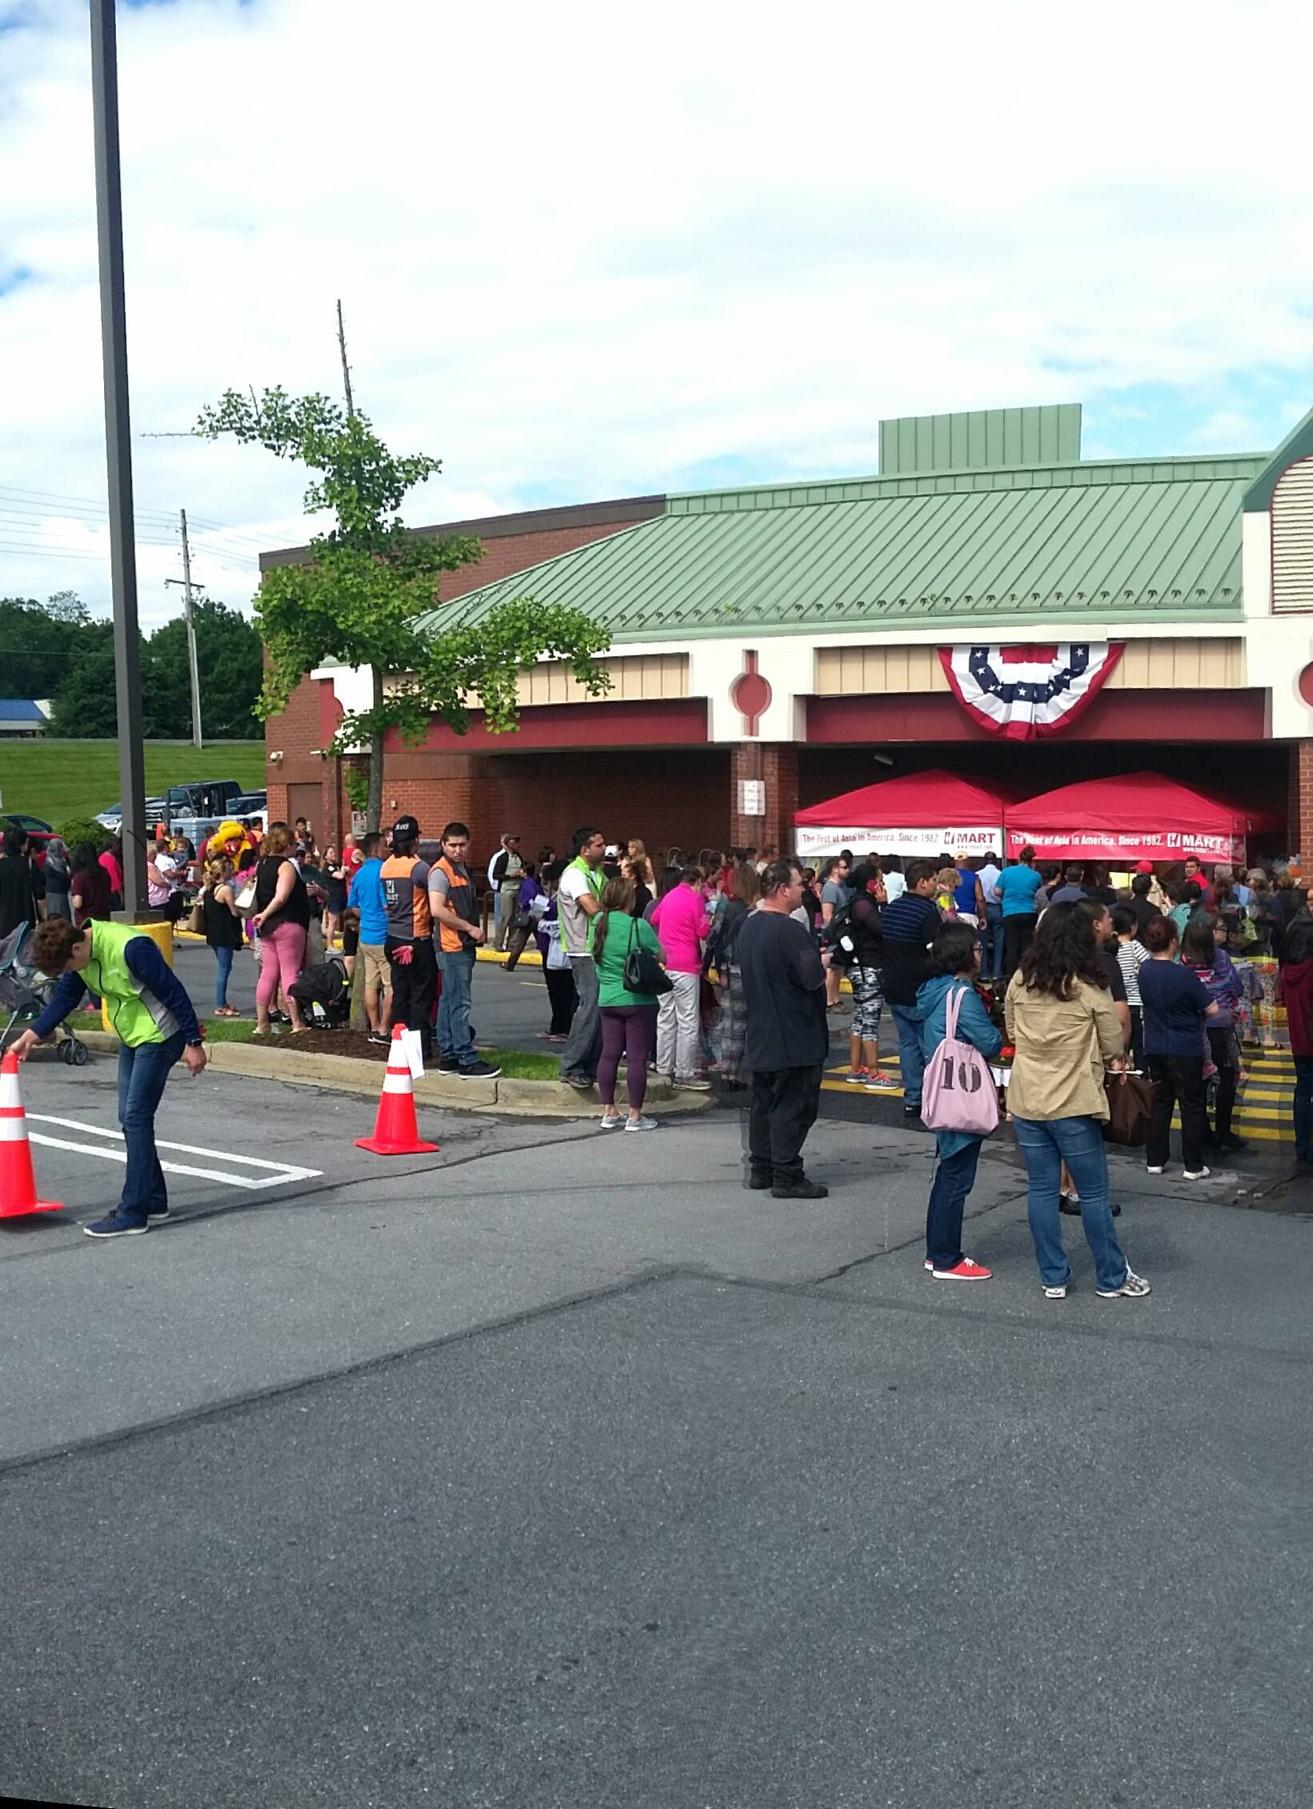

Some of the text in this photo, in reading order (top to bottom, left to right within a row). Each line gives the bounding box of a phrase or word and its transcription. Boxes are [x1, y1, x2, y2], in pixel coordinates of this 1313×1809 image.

[898, 832, 918, 842] Since
[956, 833, 996, 844] MART
[1011, 834, 1024, 845] The
[1118, 834, 1139, 846] Since
[1182, 834, 1225, 849] MART
[940, 1055, 981, 1093] 10
